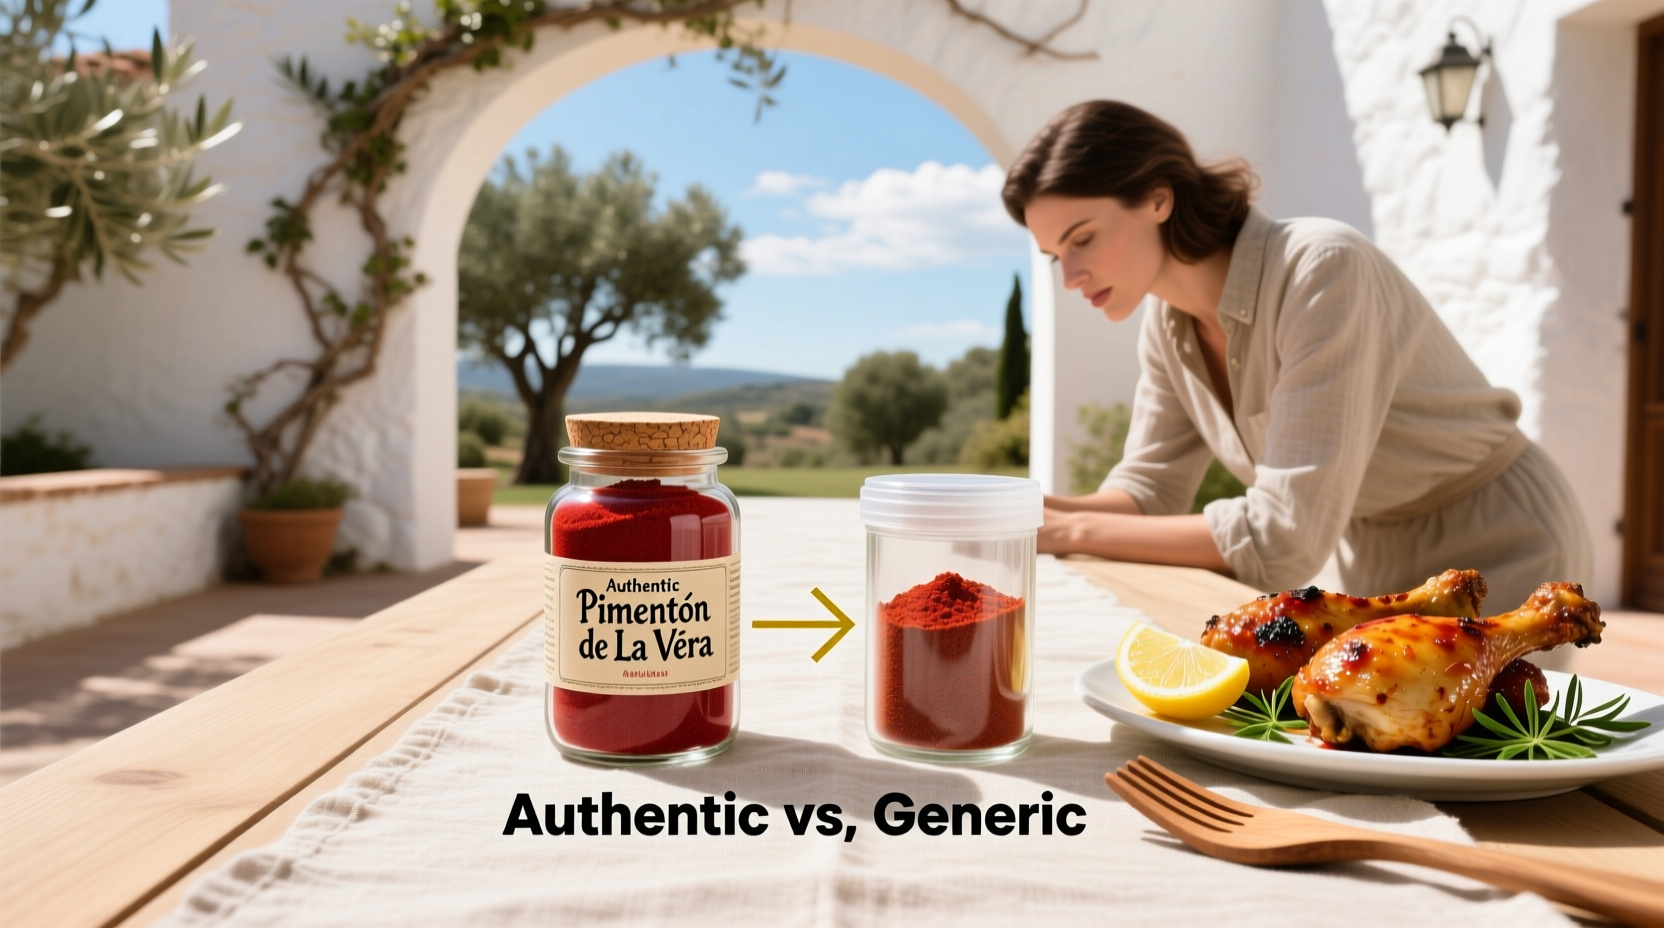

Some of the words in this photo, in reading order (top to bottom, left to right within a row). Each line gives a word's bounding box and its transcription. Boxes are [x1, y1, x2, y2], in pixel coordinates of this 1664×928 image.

[605, 577, 680, 593] Authentic
[576, 588, 711, 624] Pimentón
[578, 627, 608, 660] de
[613, 628, 649, 662] La
[653, 628, 714, 662] Véra
